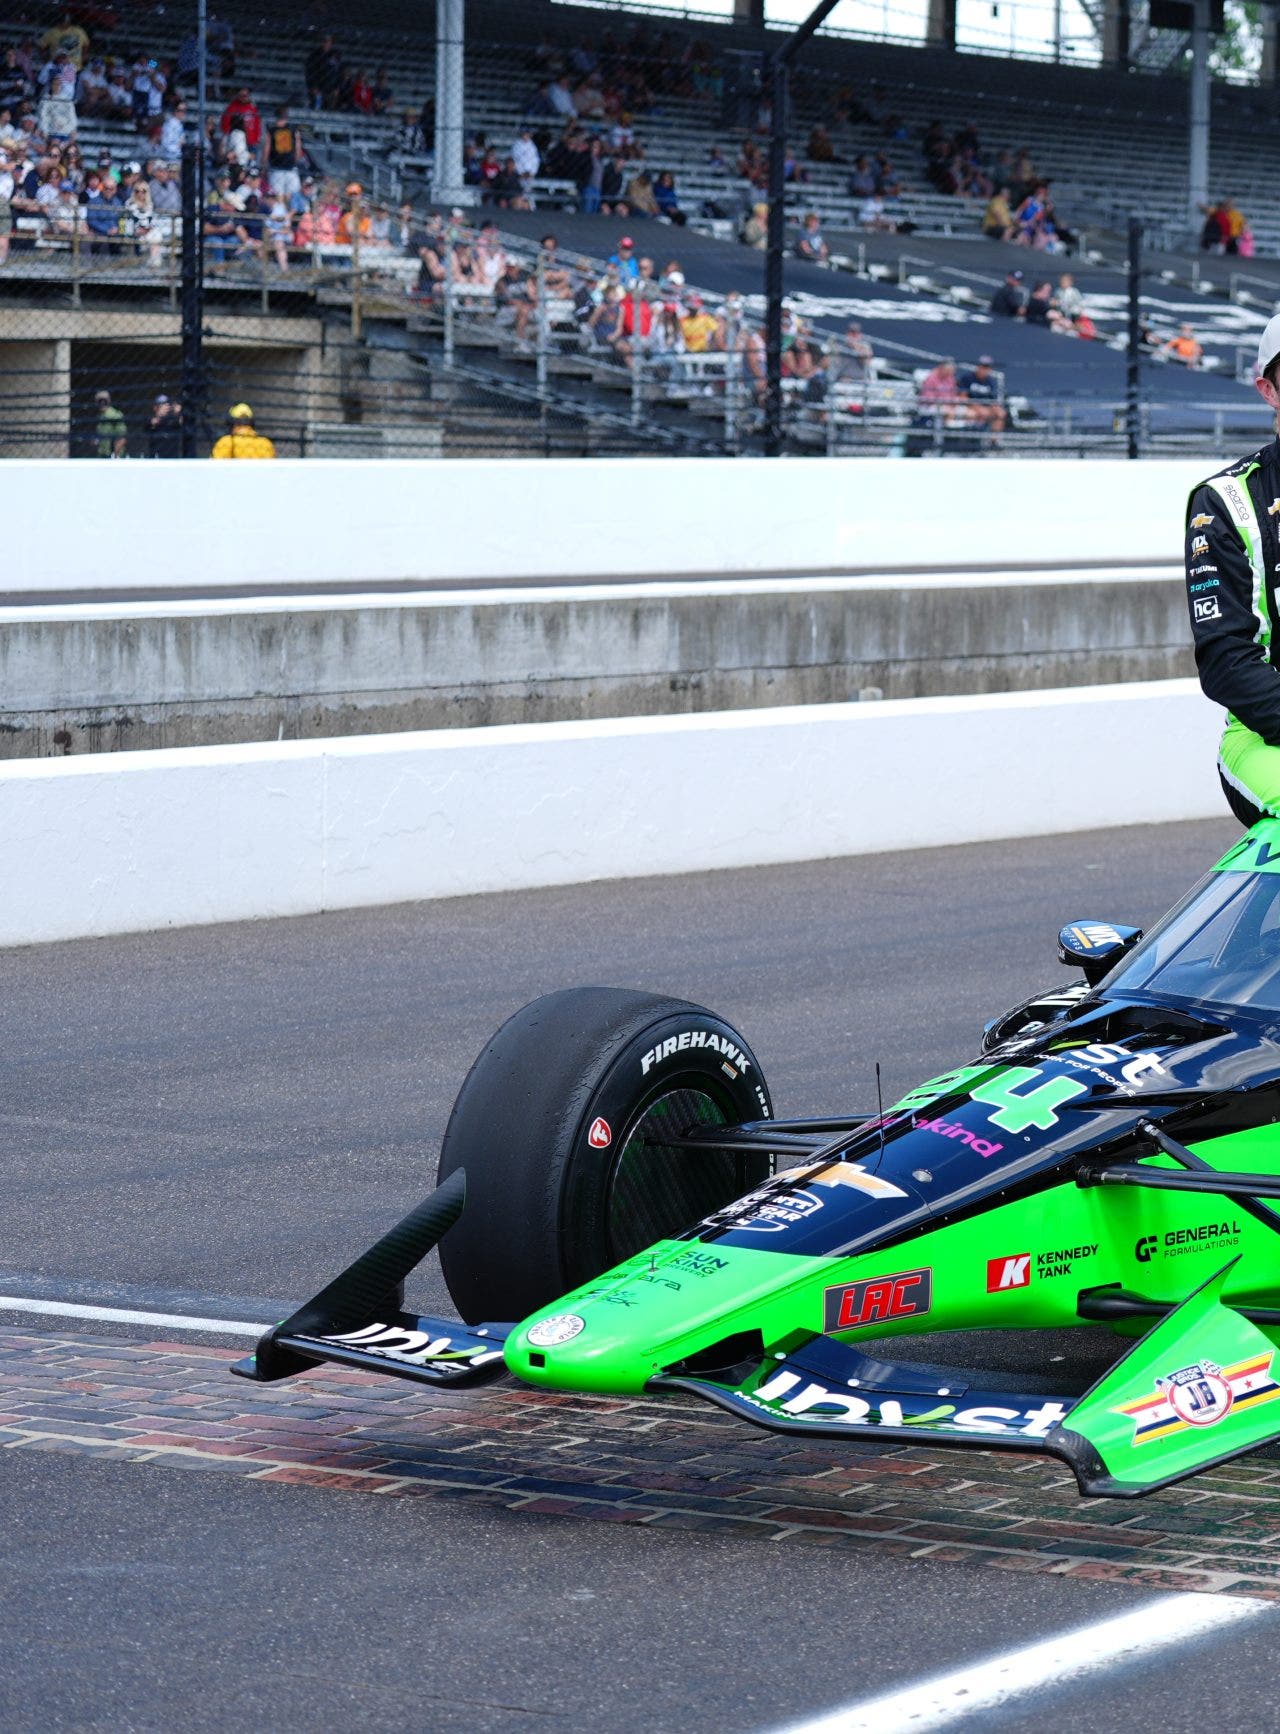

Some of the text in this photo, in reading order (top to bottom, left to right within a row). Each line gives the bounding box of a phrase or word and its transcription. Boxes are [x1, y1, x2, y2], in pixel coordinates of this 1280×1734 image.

[1225, 484, 1250, 520] sparco
[1194, 598, 1222, 621] hc1
[641, 1031, 751, 1075] FIREHAWK
[1034, 1054, 1136, 1098] ORK FOR PEOPLE
[755, 1085, 771, 1121] IND
[1164, 1220, 1242, 1247] GENERAL
[1037, 1244, 1099, 1265] KENNEDY
[1164, 1237, 1240, 1258] FORMULATIONS
[669, 1258, 719, 1275] KING
[680, 1251, 730, 1269] SUN
[1037, 1263, 1072, 1280] TANK
[838, 1274, 922, 1328] LAC
[1170, 1366, 1200, 1380] JUSTICE
